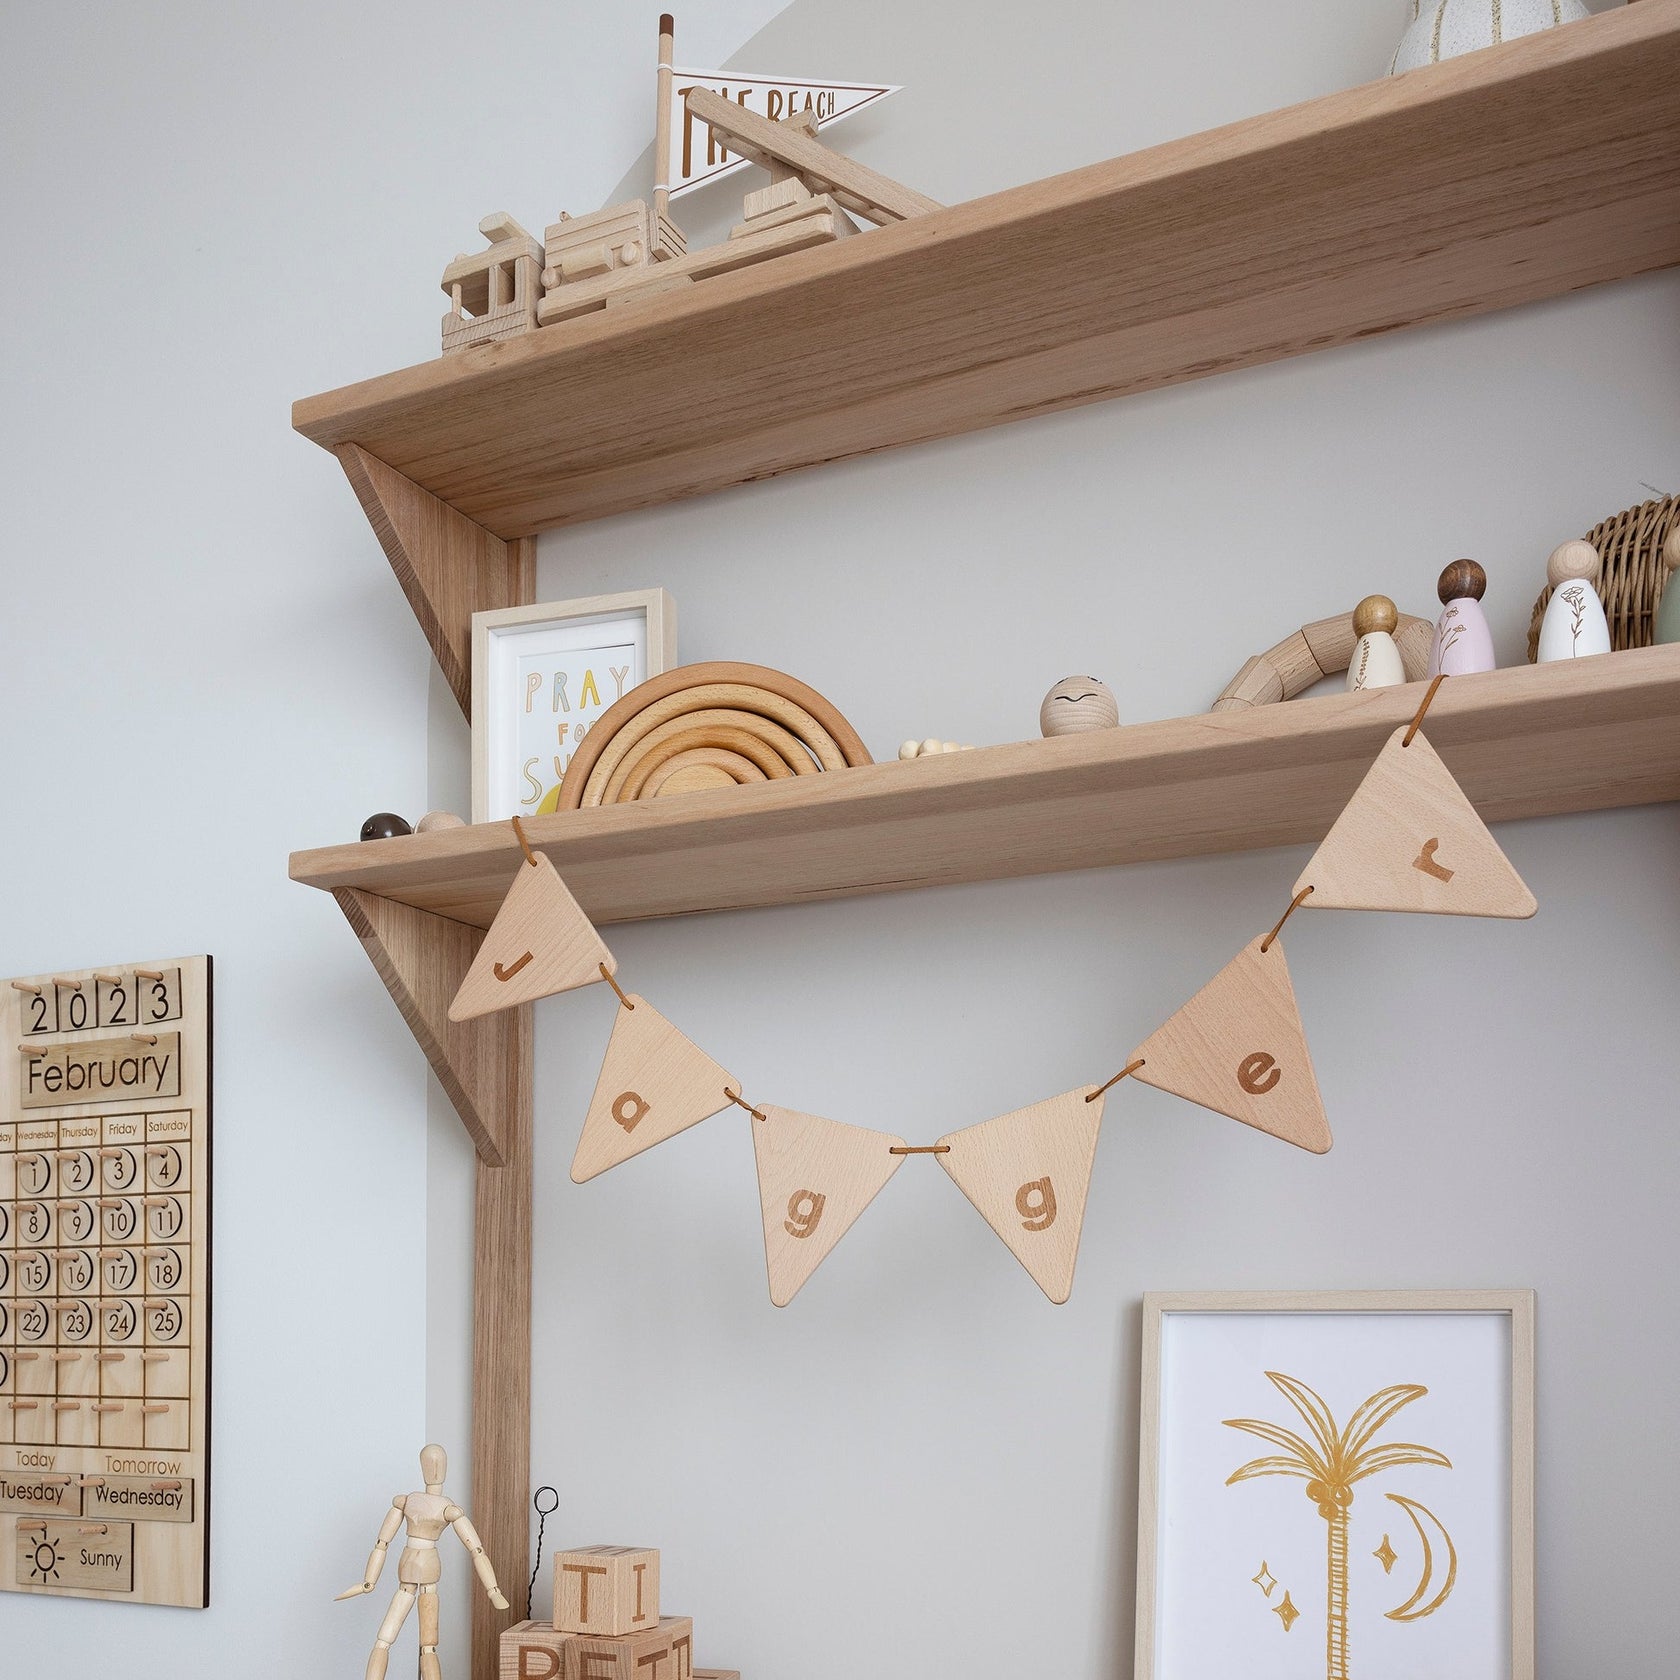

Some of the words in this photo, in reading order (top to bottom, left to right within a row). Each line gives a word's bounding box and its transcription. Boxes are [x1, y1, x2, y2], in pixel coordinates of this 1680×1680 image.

[526, 665, 630, 713] PRAY
[558, 720, 598, 745] FO
[31, 984, 169, 1032] 2023
[29, 1054, 170, 1093] February
[17, 1130, 57, 1140] Wednesday
[62, 1126, 98, 1138] Thursday
[109, 1123, 137, 1135] Friday
[149, 1120, 188, 1132] Saturday
[32, 1168, 37, 1187] 1
[72, 1164, 82, 1183] 2
[114, 1161, 124, 1181] 3
[159, 1161, 169, 1180] 4
[29, 1216, 38, 1234] 8
[72, 1216, 81, 1235] 9
[110, 1213, 128, 1232] 10
[157, 1211, 173, 1231] 11
[26, 1266, 43, 1285] 15
[69, 1266, 85, 1284] 16
[111, 1265, 128, 1284] 17
[155, 1265, 173, 1284] 18
[23, 1313, 42, 1333] 22
[66, 1314, 84, 1333] 23
[109, 1314, 129, 1333] 24
[154, 1312, 174, 1332] 25
[16, 1451, 56, 1471] Today
[105, 1455, 182, 1475] Tomorrow
[0, 1481, 64, 1505] Tuesday
[96, 1486, 183, 1510] Wednesday
[80, 1548, 123, 1571] Sunny
